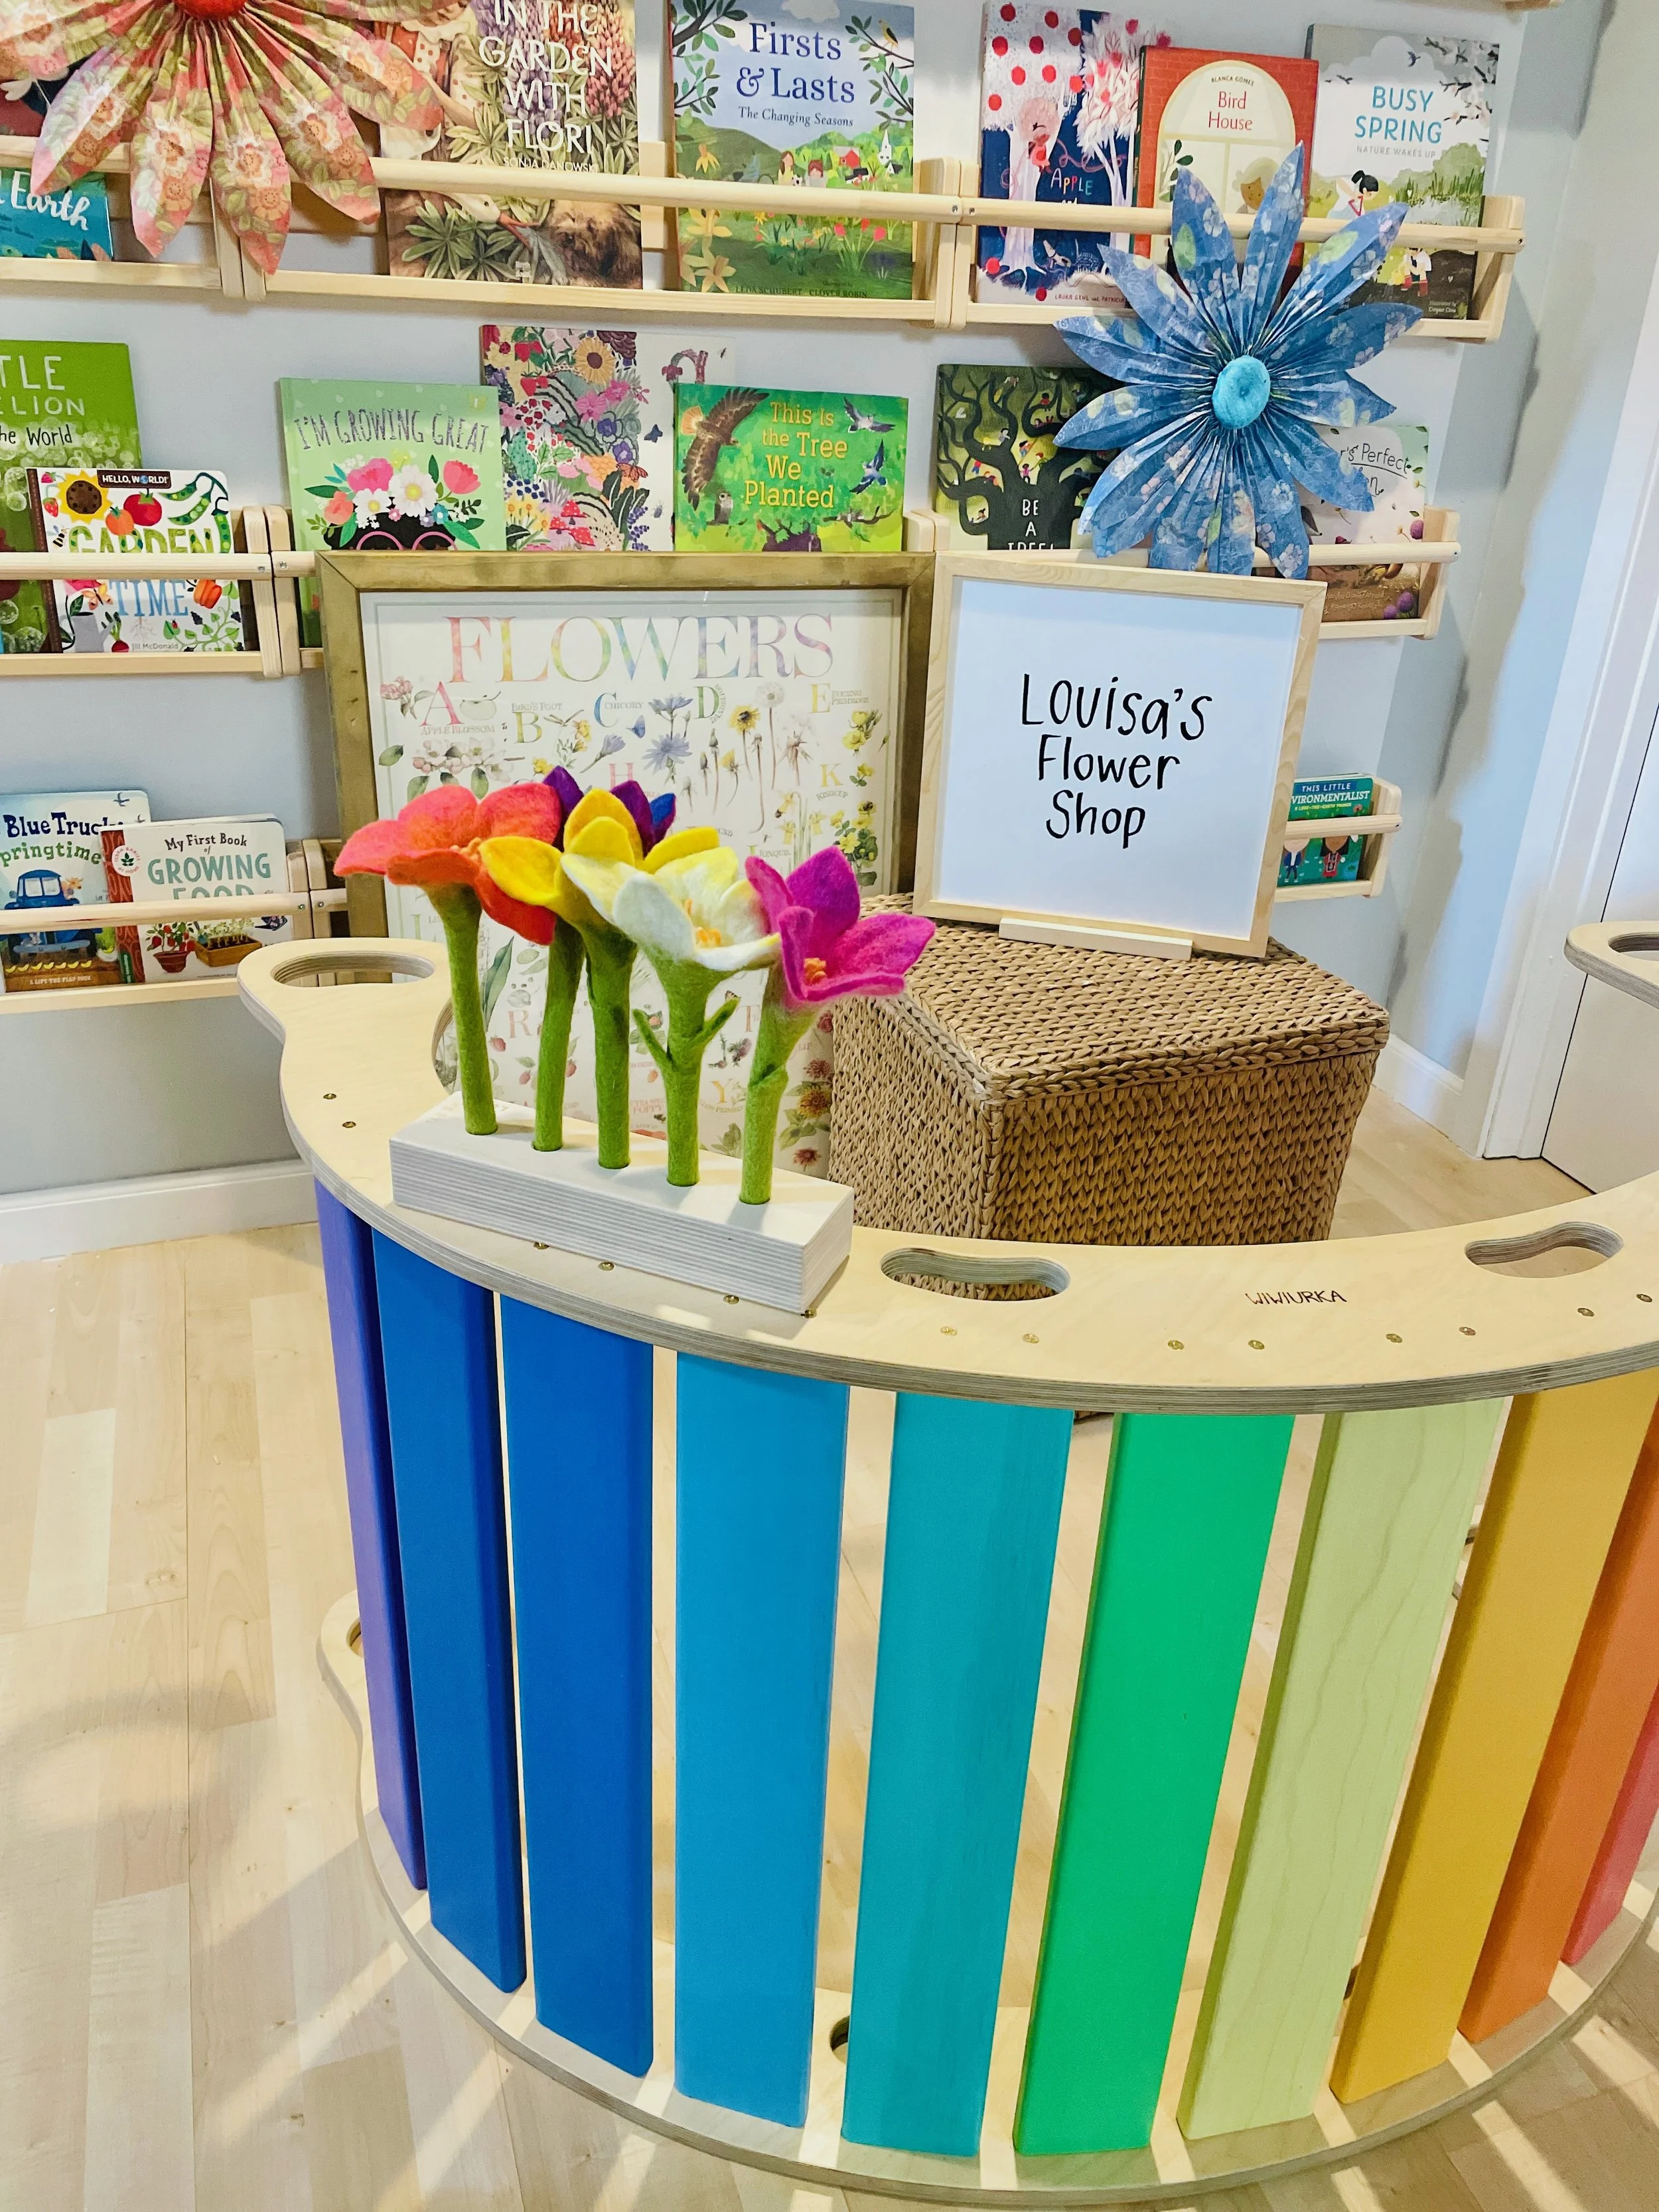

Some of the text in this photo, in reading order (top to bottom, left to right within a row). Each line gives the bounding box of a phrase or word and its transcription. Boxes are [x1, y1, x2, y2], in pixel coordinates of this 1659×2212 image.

[494, 0, 598, 35] IN THE
[749, 22, 841, 60] Firsts
[478, 36, 614, 78] GARDEN
[504, 77, 587, 115] WITH
[737, 68, 855, 104] & Lasts
[1372, 86, 1434, 111] BUSY
[1218, 91, 1247, 110] Bird
[738, 106, 854, 128] The Changing Seasons
[1207, 111, 1254, 131] House
[1354, 115, 1442, 145] SPRING
[506, 117, 592, 155] FLORI
[503, 156, 598, 173] SONJA DANOWSKI
[1356, 145, 1436, 159] NATURE WAKES UP
[1050, 169, 1093, 196] APPLE
[11, 170, 90, 231] Earth
[735, 285, 758, 294] LEDA
[758, 287, 803, 295] SCHUBERT
[0, 396, 86, 415] LION
[769, 402, 814, 425] This
[26, 423, 73, 447] World
[293, 407, 490, 455] I'M GROWING GREAT
[762, 427, 849, 459] the Tree
[765, 454, 802, 480] We
[1361, 443, 1412, 475] Perfect
[102, 475, 131, 484] HELLO,
[743, 480, 835, 510] Planted
[1022, 498, 1039, 516] BE
[68, 525, 214, 553] GARDEN
[1025, 521, 1037, 537] A
[109, 579, 189, 617] TIME
[131, 642, 179, 651] Jill McDonald
[442, 613, 833, 684] FLOWERS
[419, 680, 465, 727] A
[540, 702, 563, 711] FOOT
[593, 692, 620, 728] C
[605, 701, 644, 710] CHICORY
[692, 686, 720, 719] D
[809, 683, 830, 714] E
[1021, 673, 1213, 741] Louisa's
[421, 724, 496, 736] APPLE BLOSSOM
[512, 710, 543, 744] B
[819, 763, 843, 788] K
[1038, 733, 1181, 790] Flower
[1323, 782, 1352, 792] LITTLE
[2, 812, 123, 838] Blue Truc
[1045, 789, 1146, 849] Shop
[165, 832, 248, 852] My First Book
[203, 846, 212, 855] of
[147, 852, 272, 885] GROWING
[507, 1009, 532, 1039] R
[736, 1004, 761, 1033] T
[1244, 1290, 1348, 1305] WIWIURKA
